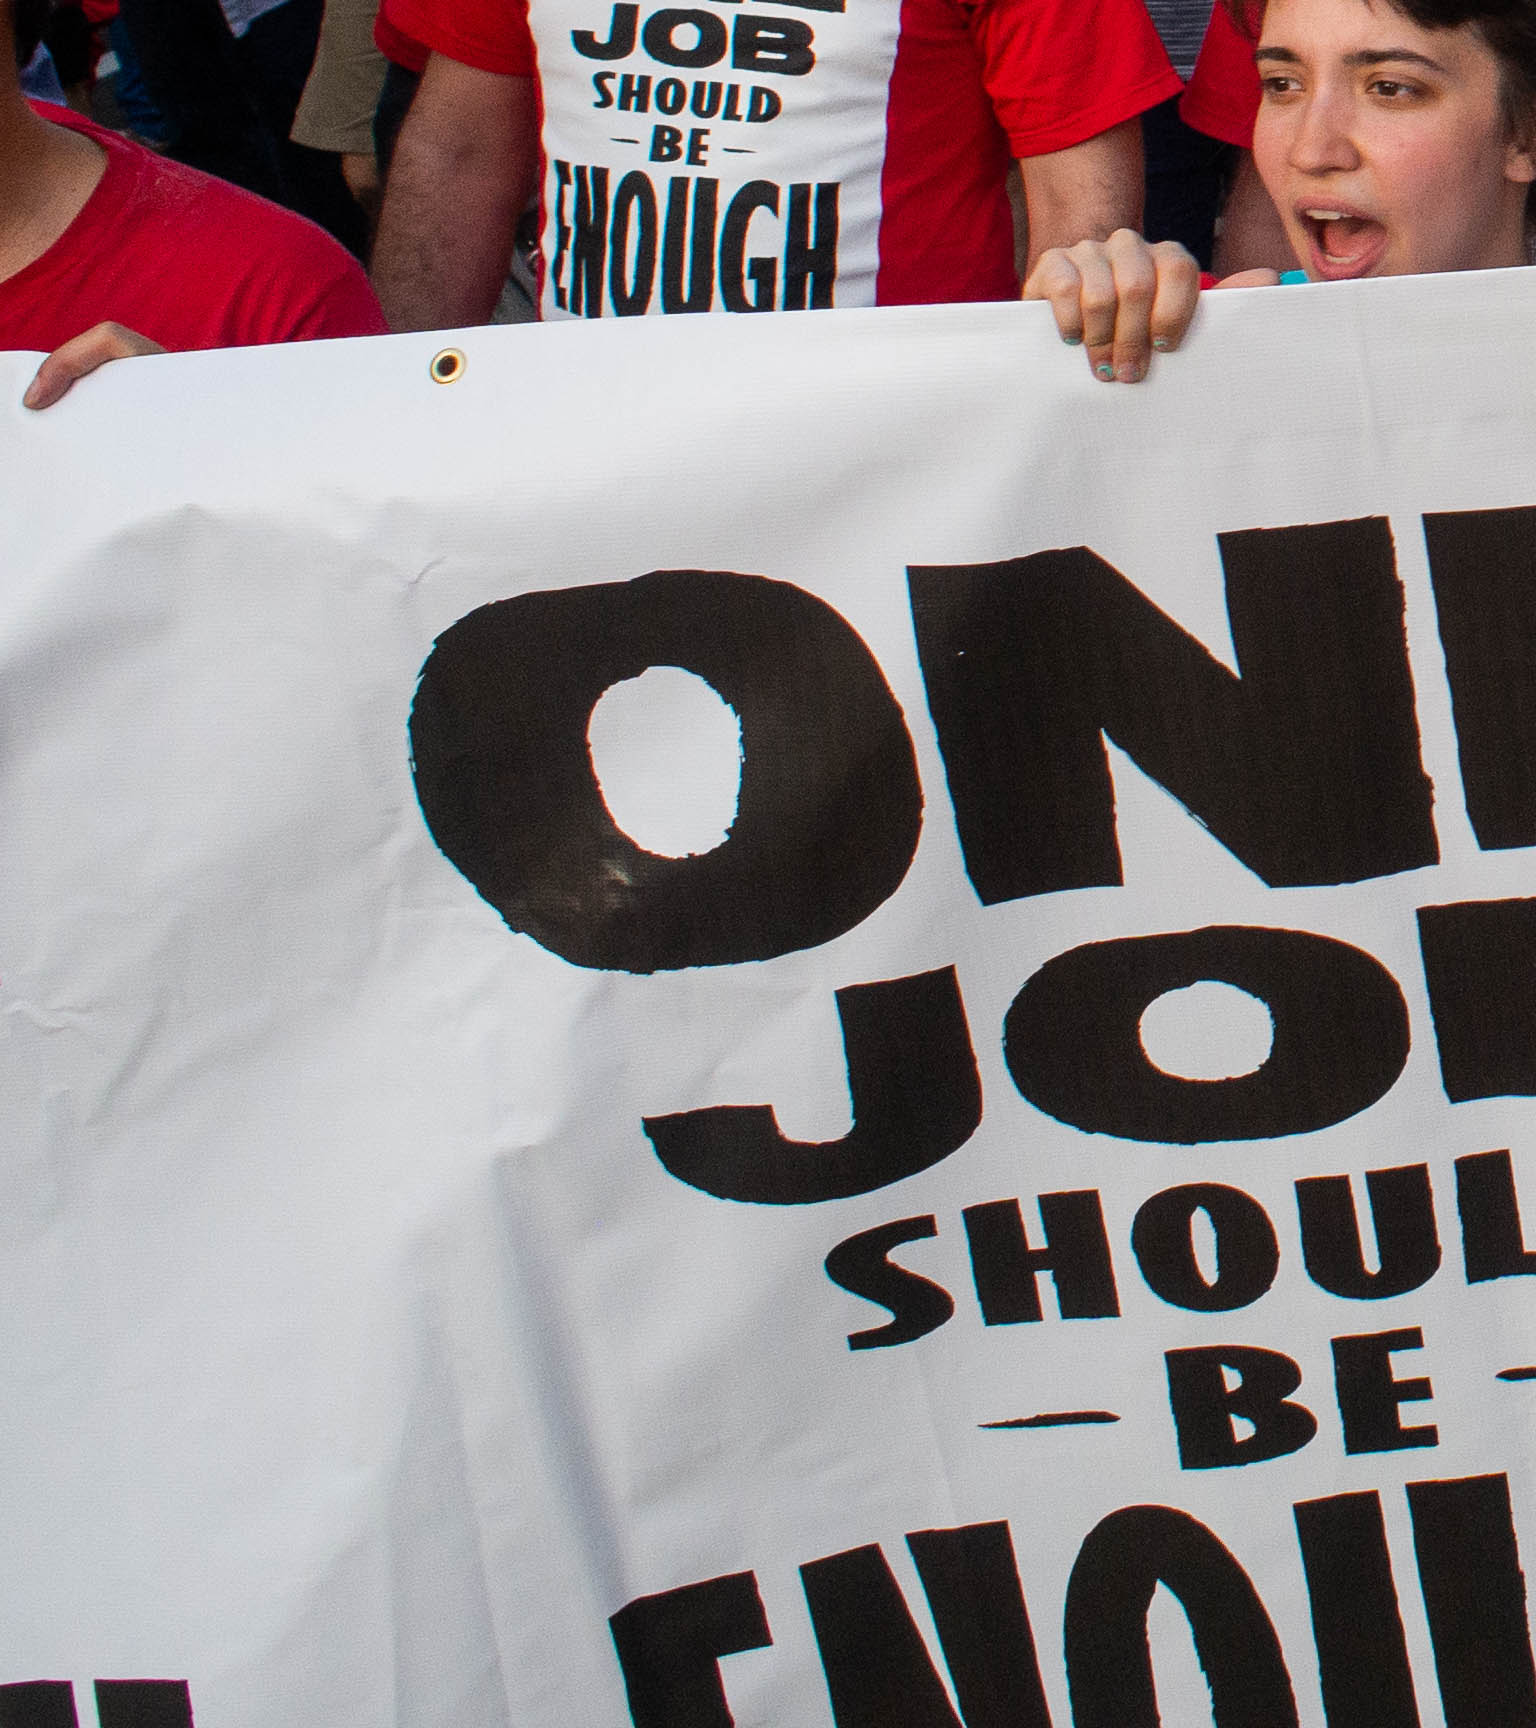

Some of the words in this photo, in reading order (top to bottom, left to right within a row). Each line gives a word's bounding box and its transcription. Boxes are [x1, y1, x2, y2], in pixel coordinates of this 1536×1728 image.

[571, 3, 816, 77] JOB
[592, 71, 782, 124] SHOULD
[649, 123, 711, 167] BE
[552, 159, 840, 319] ENOUGH
[1164, 1326, 1442, 1472] BE
